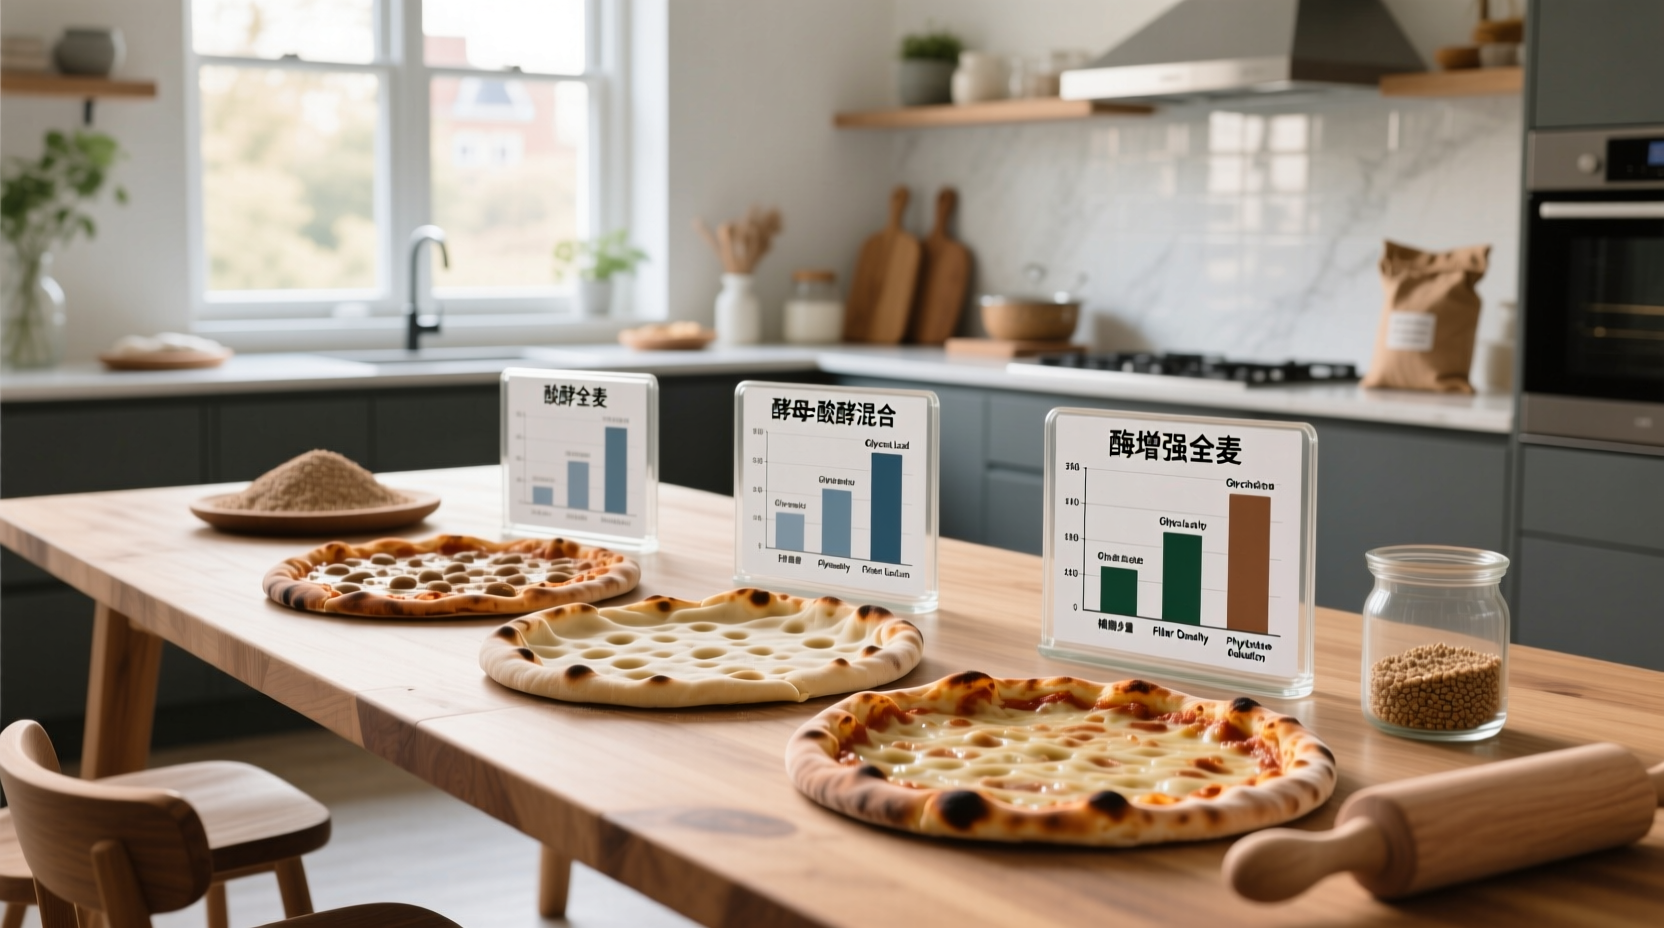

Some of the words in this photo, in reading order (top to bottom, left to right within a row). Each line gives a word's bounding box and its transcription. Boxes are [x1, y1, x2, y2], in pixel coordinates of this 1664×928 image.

[1109, 429, 1242, 465] 酶增强全麦
